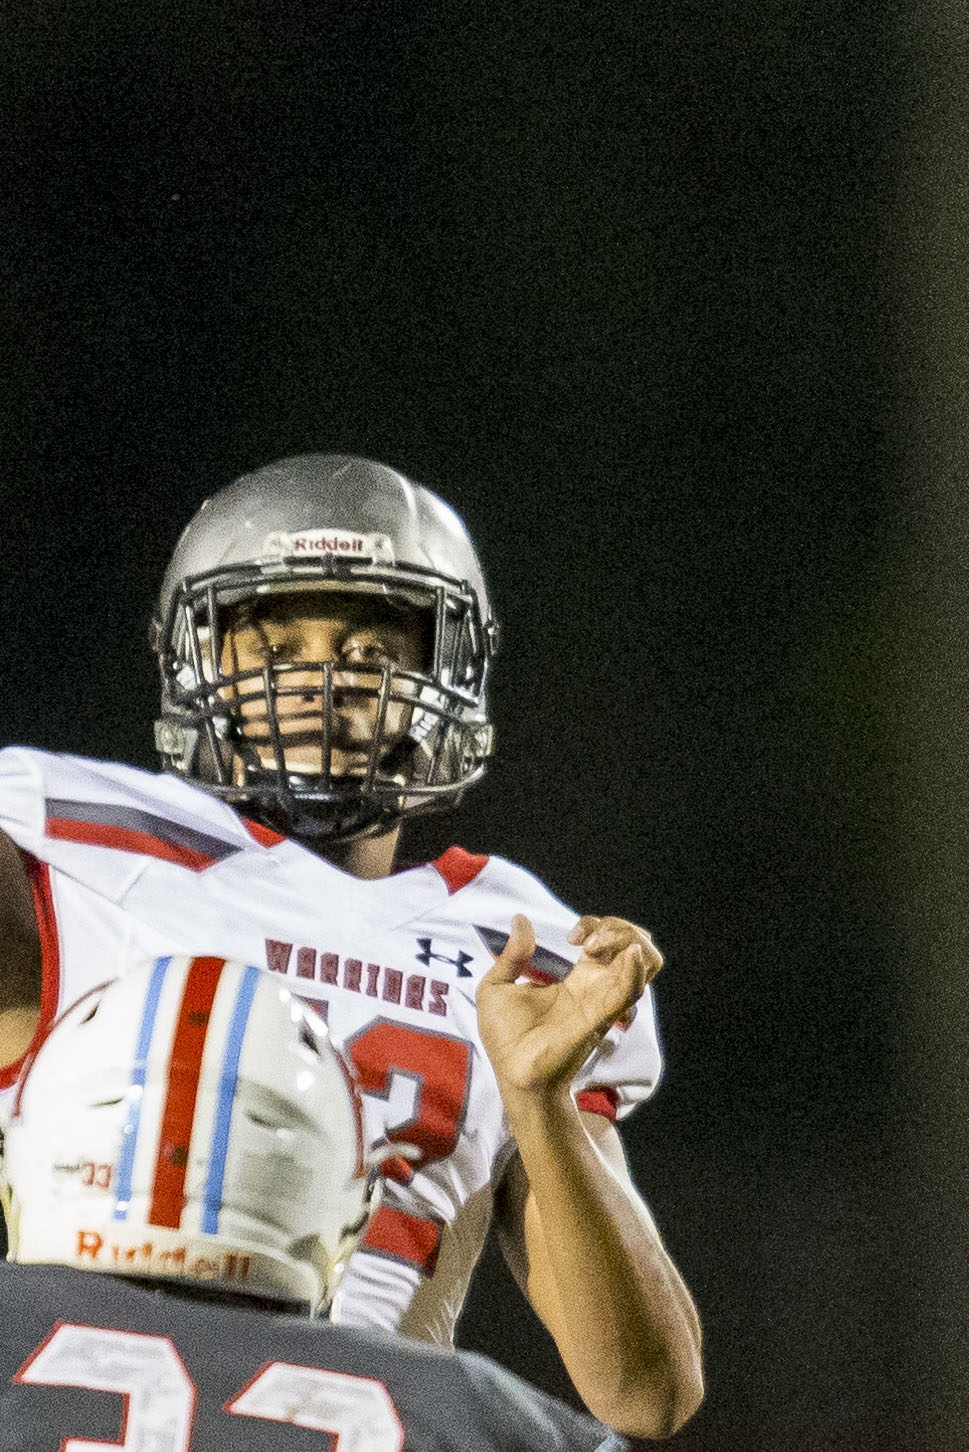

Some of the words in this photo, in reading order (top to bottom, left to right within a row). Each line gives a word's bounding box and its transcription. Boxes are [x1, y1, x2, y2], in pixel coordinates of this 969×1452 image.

[294, 536, 364, 551] Riddell
[264, 937, 450, 1018] WARRIORS
[80, 1161, 113, 1189] 33
